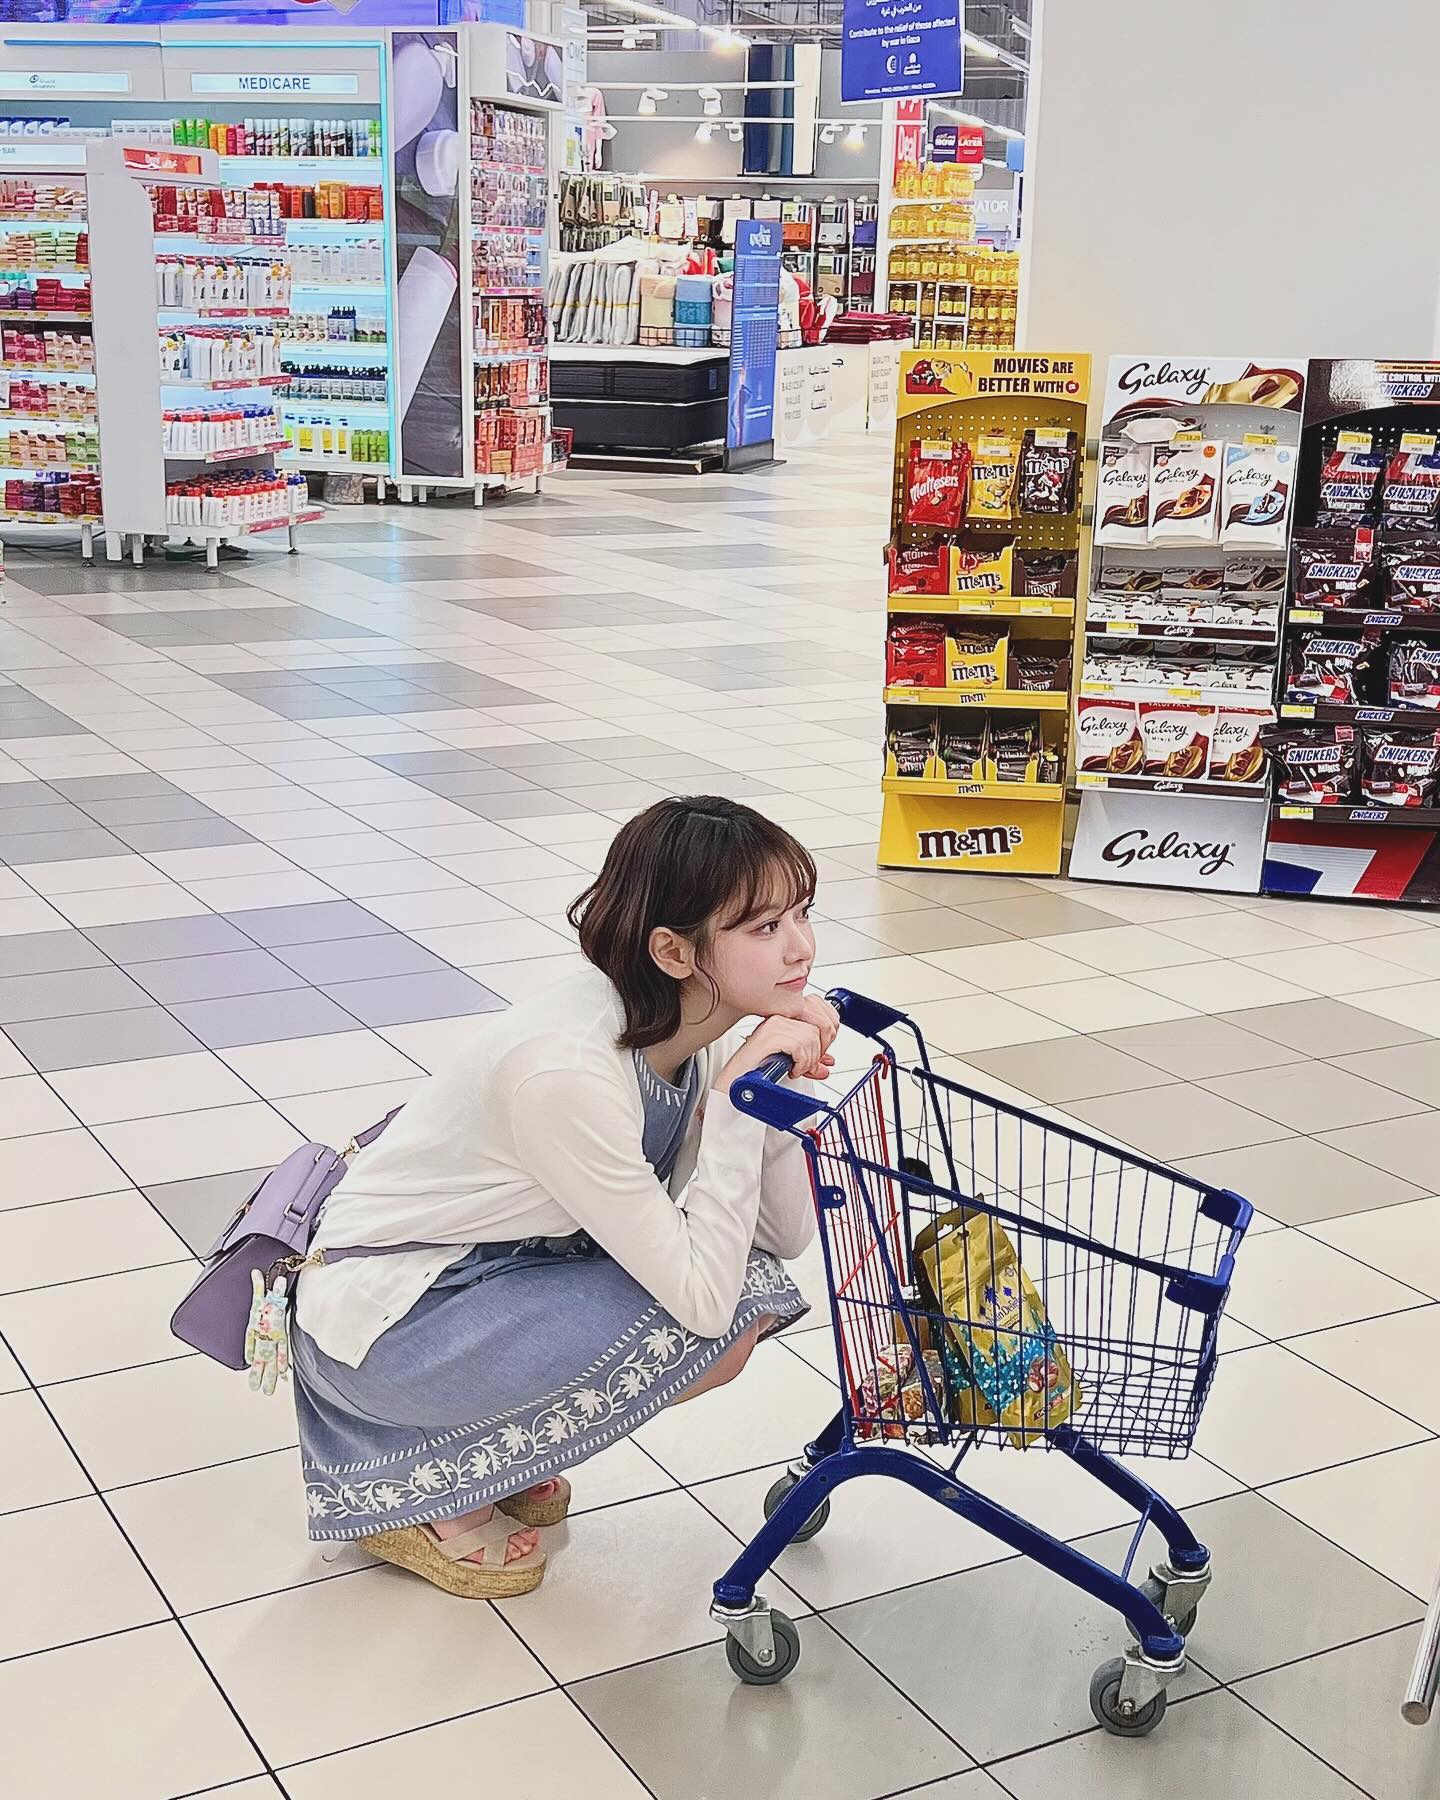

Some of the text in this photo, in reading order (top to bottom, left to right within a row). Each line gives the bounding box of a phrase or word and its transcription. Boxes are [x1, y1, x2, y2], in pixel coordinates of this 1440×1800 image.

[849, 28, 877, 38] Contribute
[894, 22, 908, 33] relief
[915, 21, 932, 30] those
[932, 17, 956, 28] affected
[881, 39, 890, 48] by
[890, 39, 899, 47] war
[906, 36, 920, 45] Gaza
[239, 77, 311, 90] MEDICARE
[993, 358, 1074, 374] MOVIES ARE
[978, 377, 1064, 393] BETTER WITH
[1118, 362, 1210, 396] Galaxy
[1103, 469, 1148, 488] Galaxy
[1155, 467, 1200, 484] Galaxy
[1227, 468, 1271, 487] Galaxy
[910, 474, 959, 506] Maltesers
[1322, 485, 1372, 498] SNICKERS
[1385, 486, 1437, 500] SNICKERS
[1104, 567, 1136, 576] Galaxy
[1164, 567, 1196, 576] Galaxy
[1226, 563, 1260, 574] Galaxy
[1309, 565, 1361, 578] SNICKERS
[1366, 615, 1401, 624] SNICKERS
[1164, 626, 1196, 637] Galaxy
[1306, 640, 1361, 657] SNICKERS
[1357, 711, 1392, 720] SNICKERS
[1081, 716, 1129, 735] Galaxy
[1145, 720, 1189, 740] Galaxy
[1288, 748, 1339, 762] SNICKERS
[1379, 747, 1435, 763] SNICKERS
[1153, 781, 1184, 792] Galaxy
[1351, 810, 1387, 820] SNICKERS
[1102, 829, 1235, 875] Galaxy
